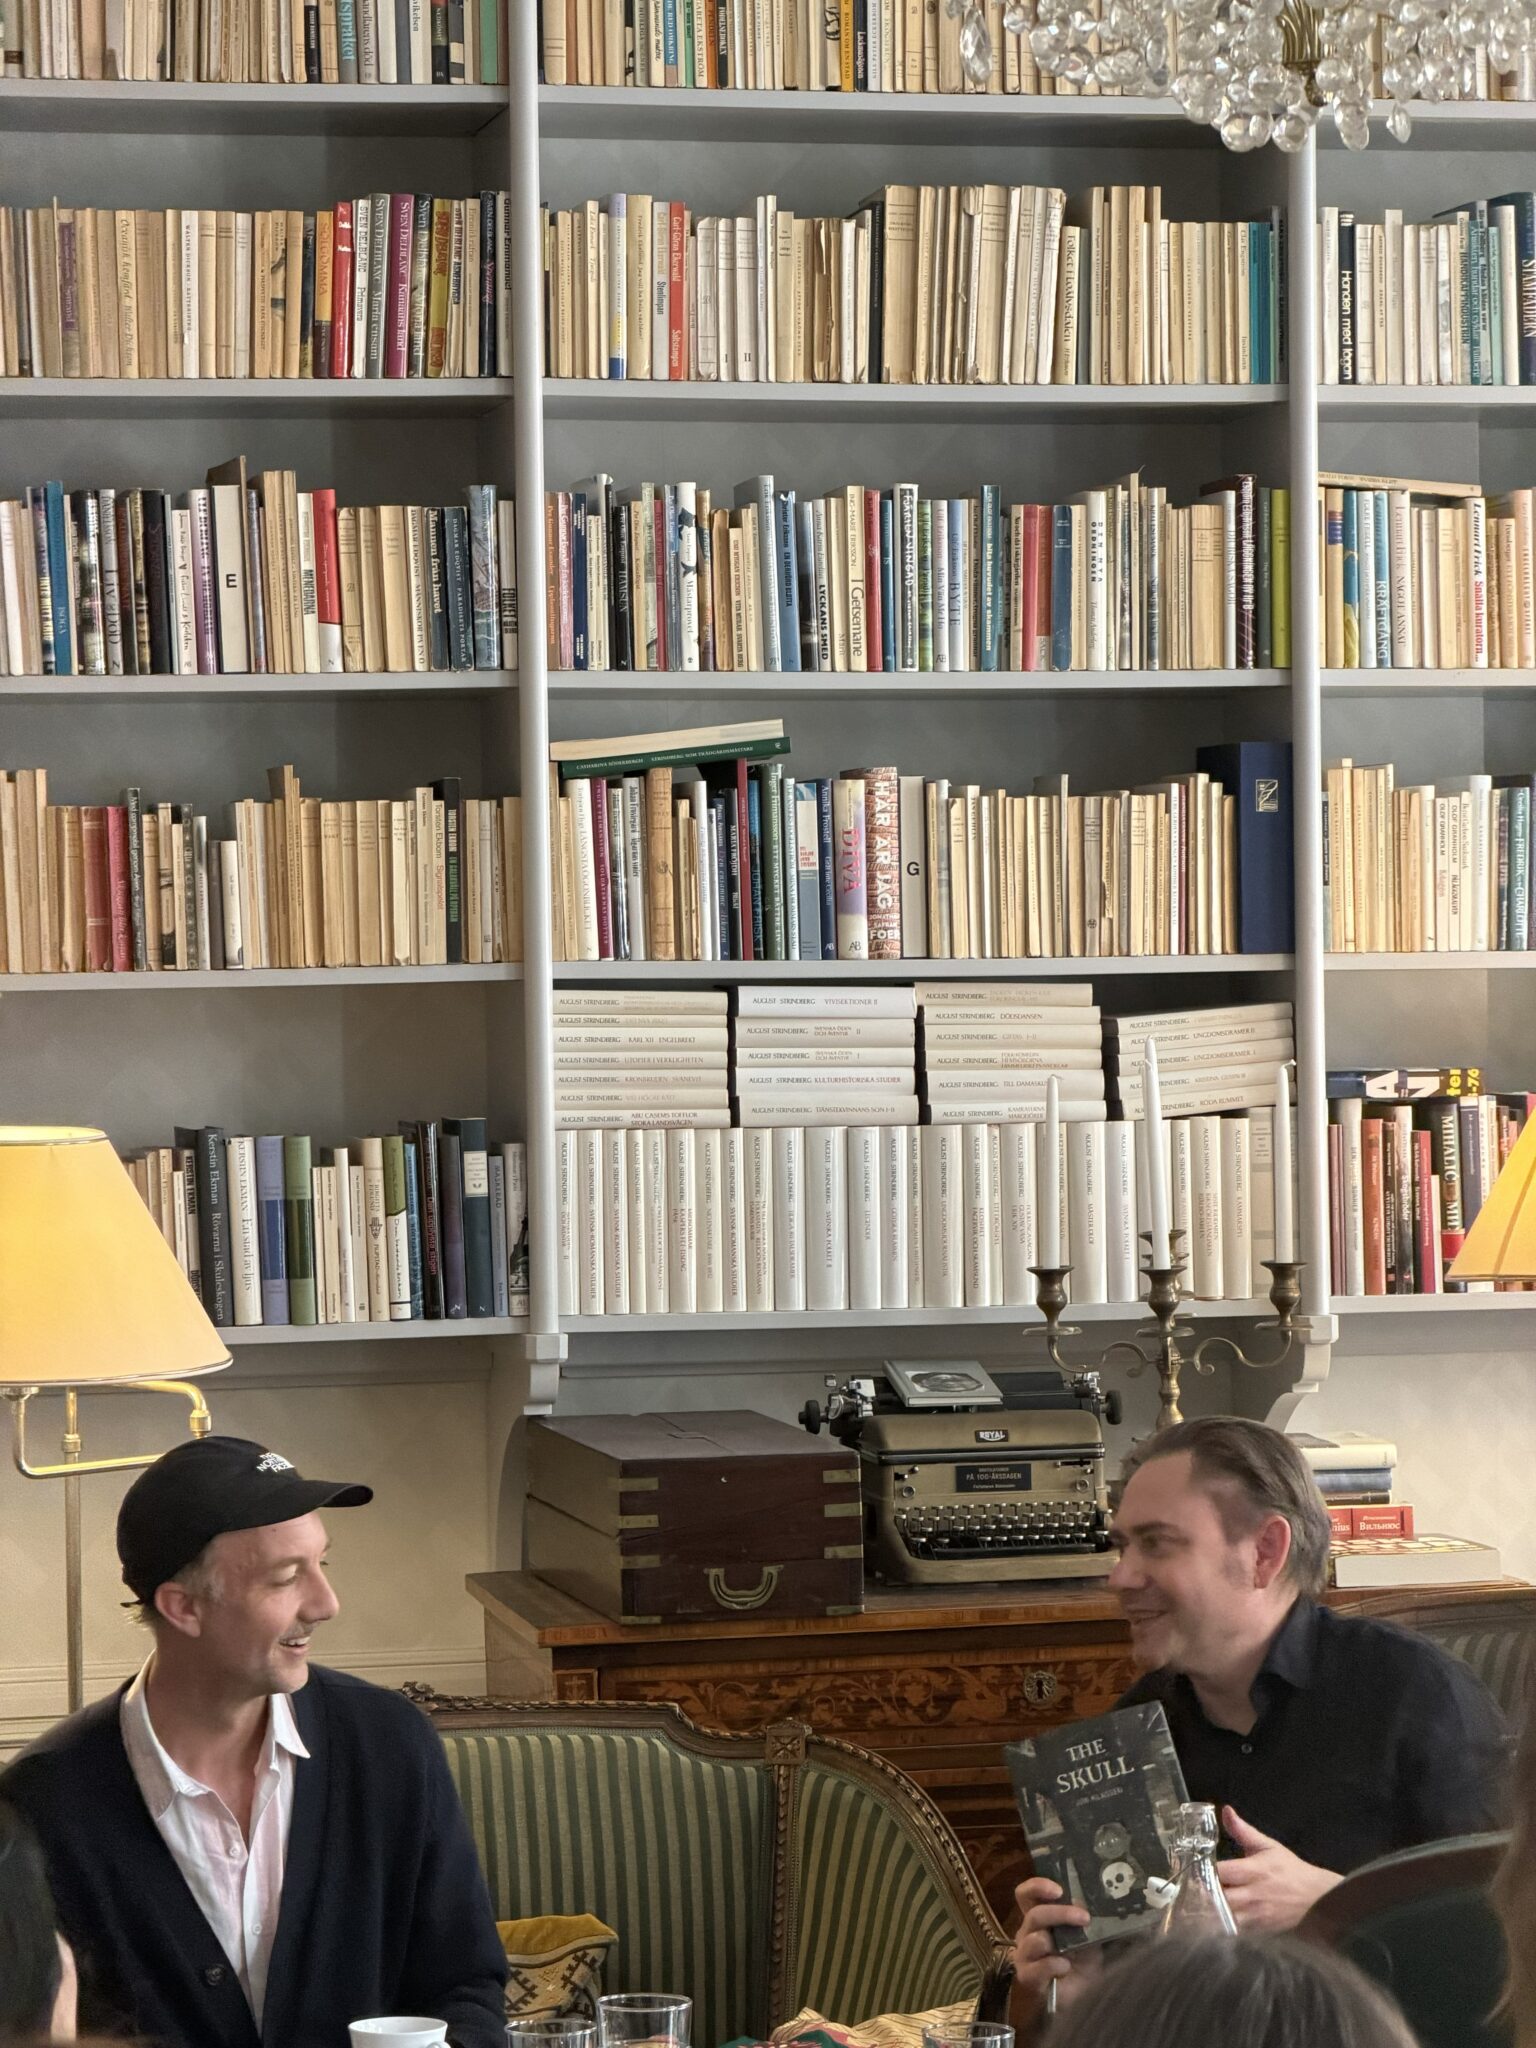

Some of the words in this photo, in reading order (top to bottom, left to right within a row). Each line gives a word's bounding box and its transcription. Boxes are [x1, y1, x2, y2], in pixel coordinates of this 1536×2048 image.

[375, 199, 385, 227] SVEN
[400, 202, 410, 227] SVEN
[419, 201, 429, 227] Sven
[1341, 270, 1353, 315] Handen
[370, 324, 380, 359] ensam
[396, 329, 406, 351] land
[1342, 318, 1352, 344] med
[1341, 348, 1353, 380] lågan
[429, 510, 438, 556] Mannen
[561, 516, 569, 541] Gunnar
[1473, 503, 1481, 547] Lennart
[430, 558, 440, 580] från
[1474, 548, 1482, 576] Frick
[226, 573, 238, 588] E
[936, 586, 945, 601] Vän
[432, 583, 442, 613] havet
[937, 603, 945, 615] Mr
[949, 582, 960, 626] BYTE
[851, 588, 865, 656] Getsemane
[937, 617, 946, 630] Ho
[1376, 580, 1388, 659] KRÄFTGÅNG
[769, 771, 778, 792] Inger
[821, 786, 830, 813] Annika
[875, 782, 892, 827] HÄR
[823, 815, 831, 843] Frostell
[435, 832, 443, 859] Ekbom
[875, 836, 892, 865] ÄR
[842, 828, 861, 896] DIVA
[906, 862, 920, 876] G
[876, 873, 893, 909] JAG
[208, 1134, 219, 1168] Kerstin
[185, 1156, 194, 1186] KERSTIN
[210, 1170, 220, 1204] Ekman
[240, 1180, 248, 1211] EKMAN
[187, 1188, 196, 1215] EKMAN
[211, 1213, 222, 1252] Rövarna
[241, 1218, 252, 1234] En
[242, 1236, 253, 1258] stad
[244, 1259, 252, 1271] av
[214, 1261, 226, 1320] Skuleskogen
[1359, 1522, 1400, 1531] Вильнюс
[1065, 1739, 1106, 1761] THE
[1057, 1756, 1135, 1793] SKULL
